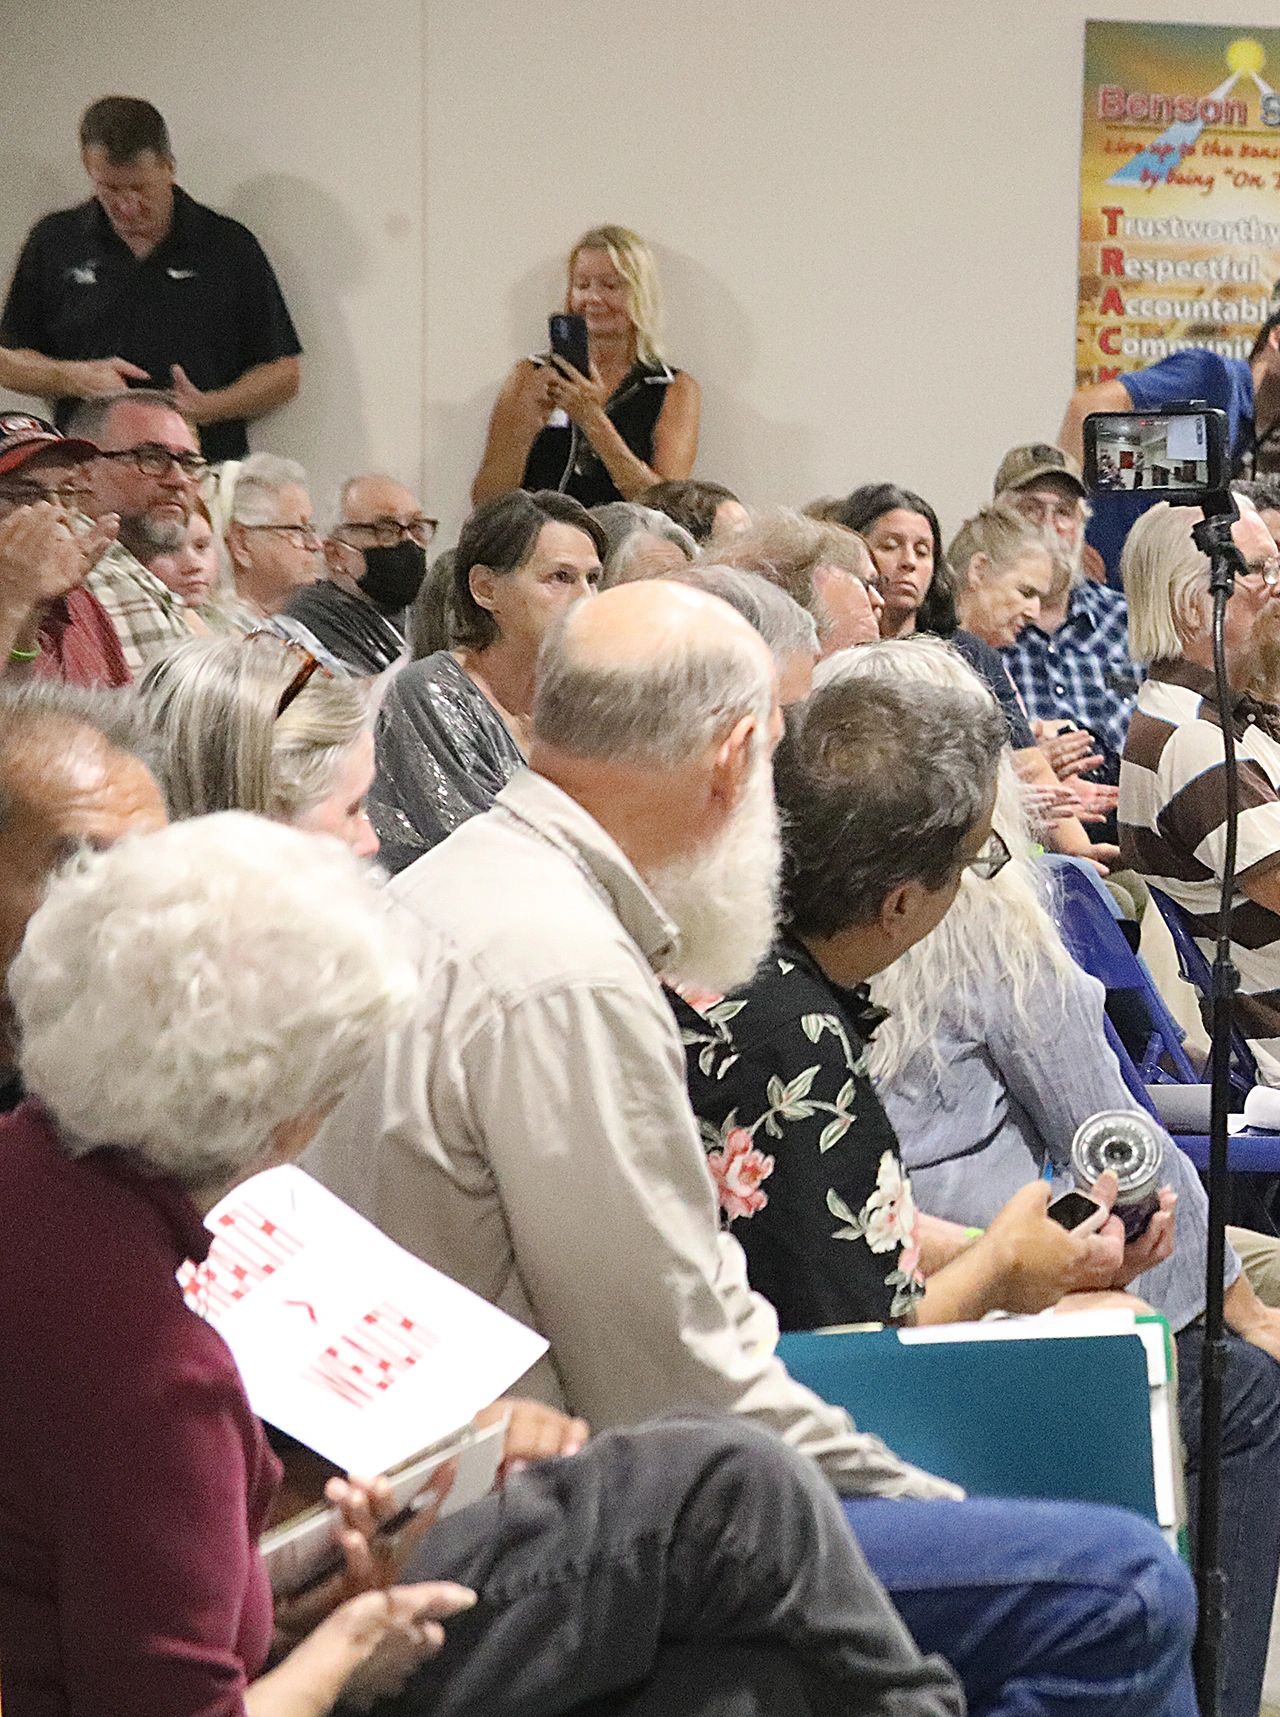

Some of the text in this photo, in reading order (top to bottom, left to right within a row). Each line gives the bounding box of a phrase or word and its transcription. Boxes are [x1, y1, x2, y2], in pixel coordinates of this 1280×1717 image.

[1098, 84, 1248, 127] Benson
[1202, 138, 1233, 157] the
[1140, 167, 1160, 193] by
[1166, 167, 1215, 196] being
[1102, 247, 1260, 283] Respectful
[301, 1301, 441, 1411] WEALTH
